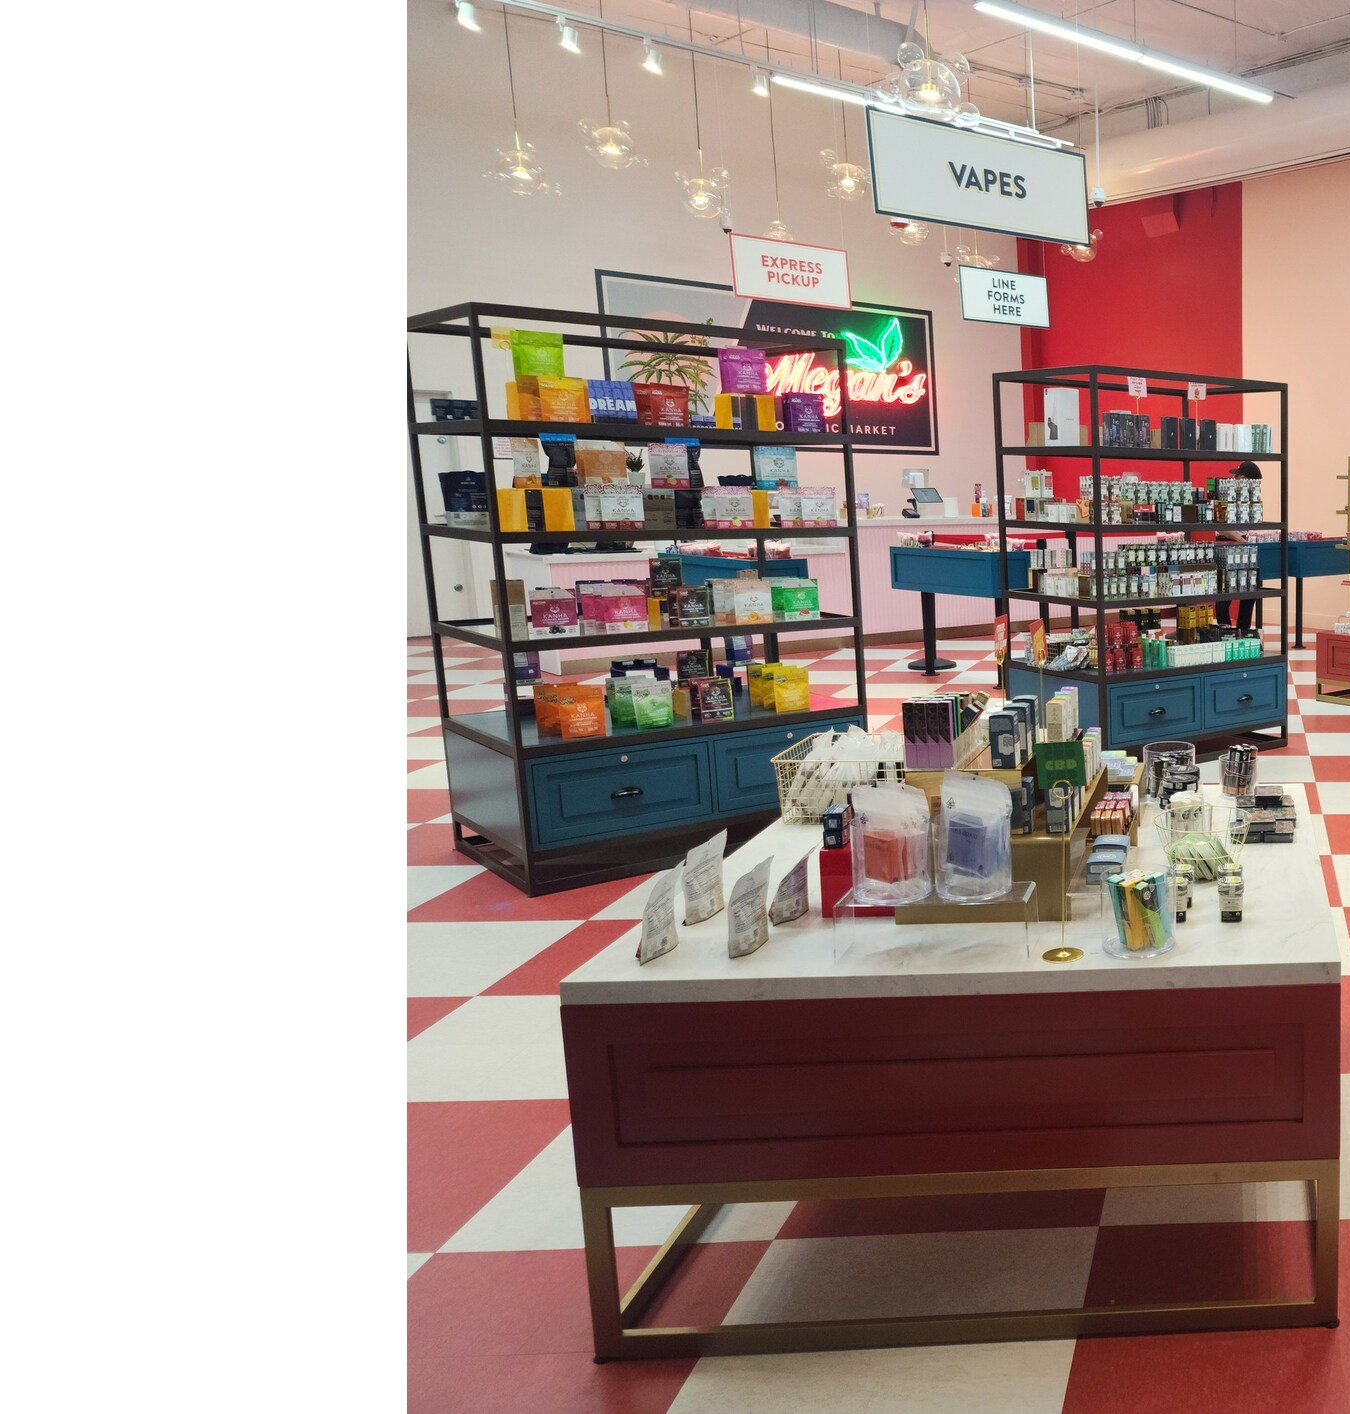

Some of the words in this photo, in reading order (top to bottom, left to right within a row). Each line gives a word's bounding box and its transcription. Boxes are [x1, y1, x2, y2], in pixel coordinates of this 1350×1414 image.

[948, 160, 1027, 200] VAPES
[761, 254, 823, 275] EXPRESS
[767, 270, 820, 289] PICKUP
[992, 277, 1016, 291] LINE
[987, 290, 1026, 305] FORMS
[993, 304, 1022, 317] HERE
[590, 398, 637, 411] DREAM
[850, 424, 896, 435] ARKET
[1045, 759, 1077, 770] CBD
